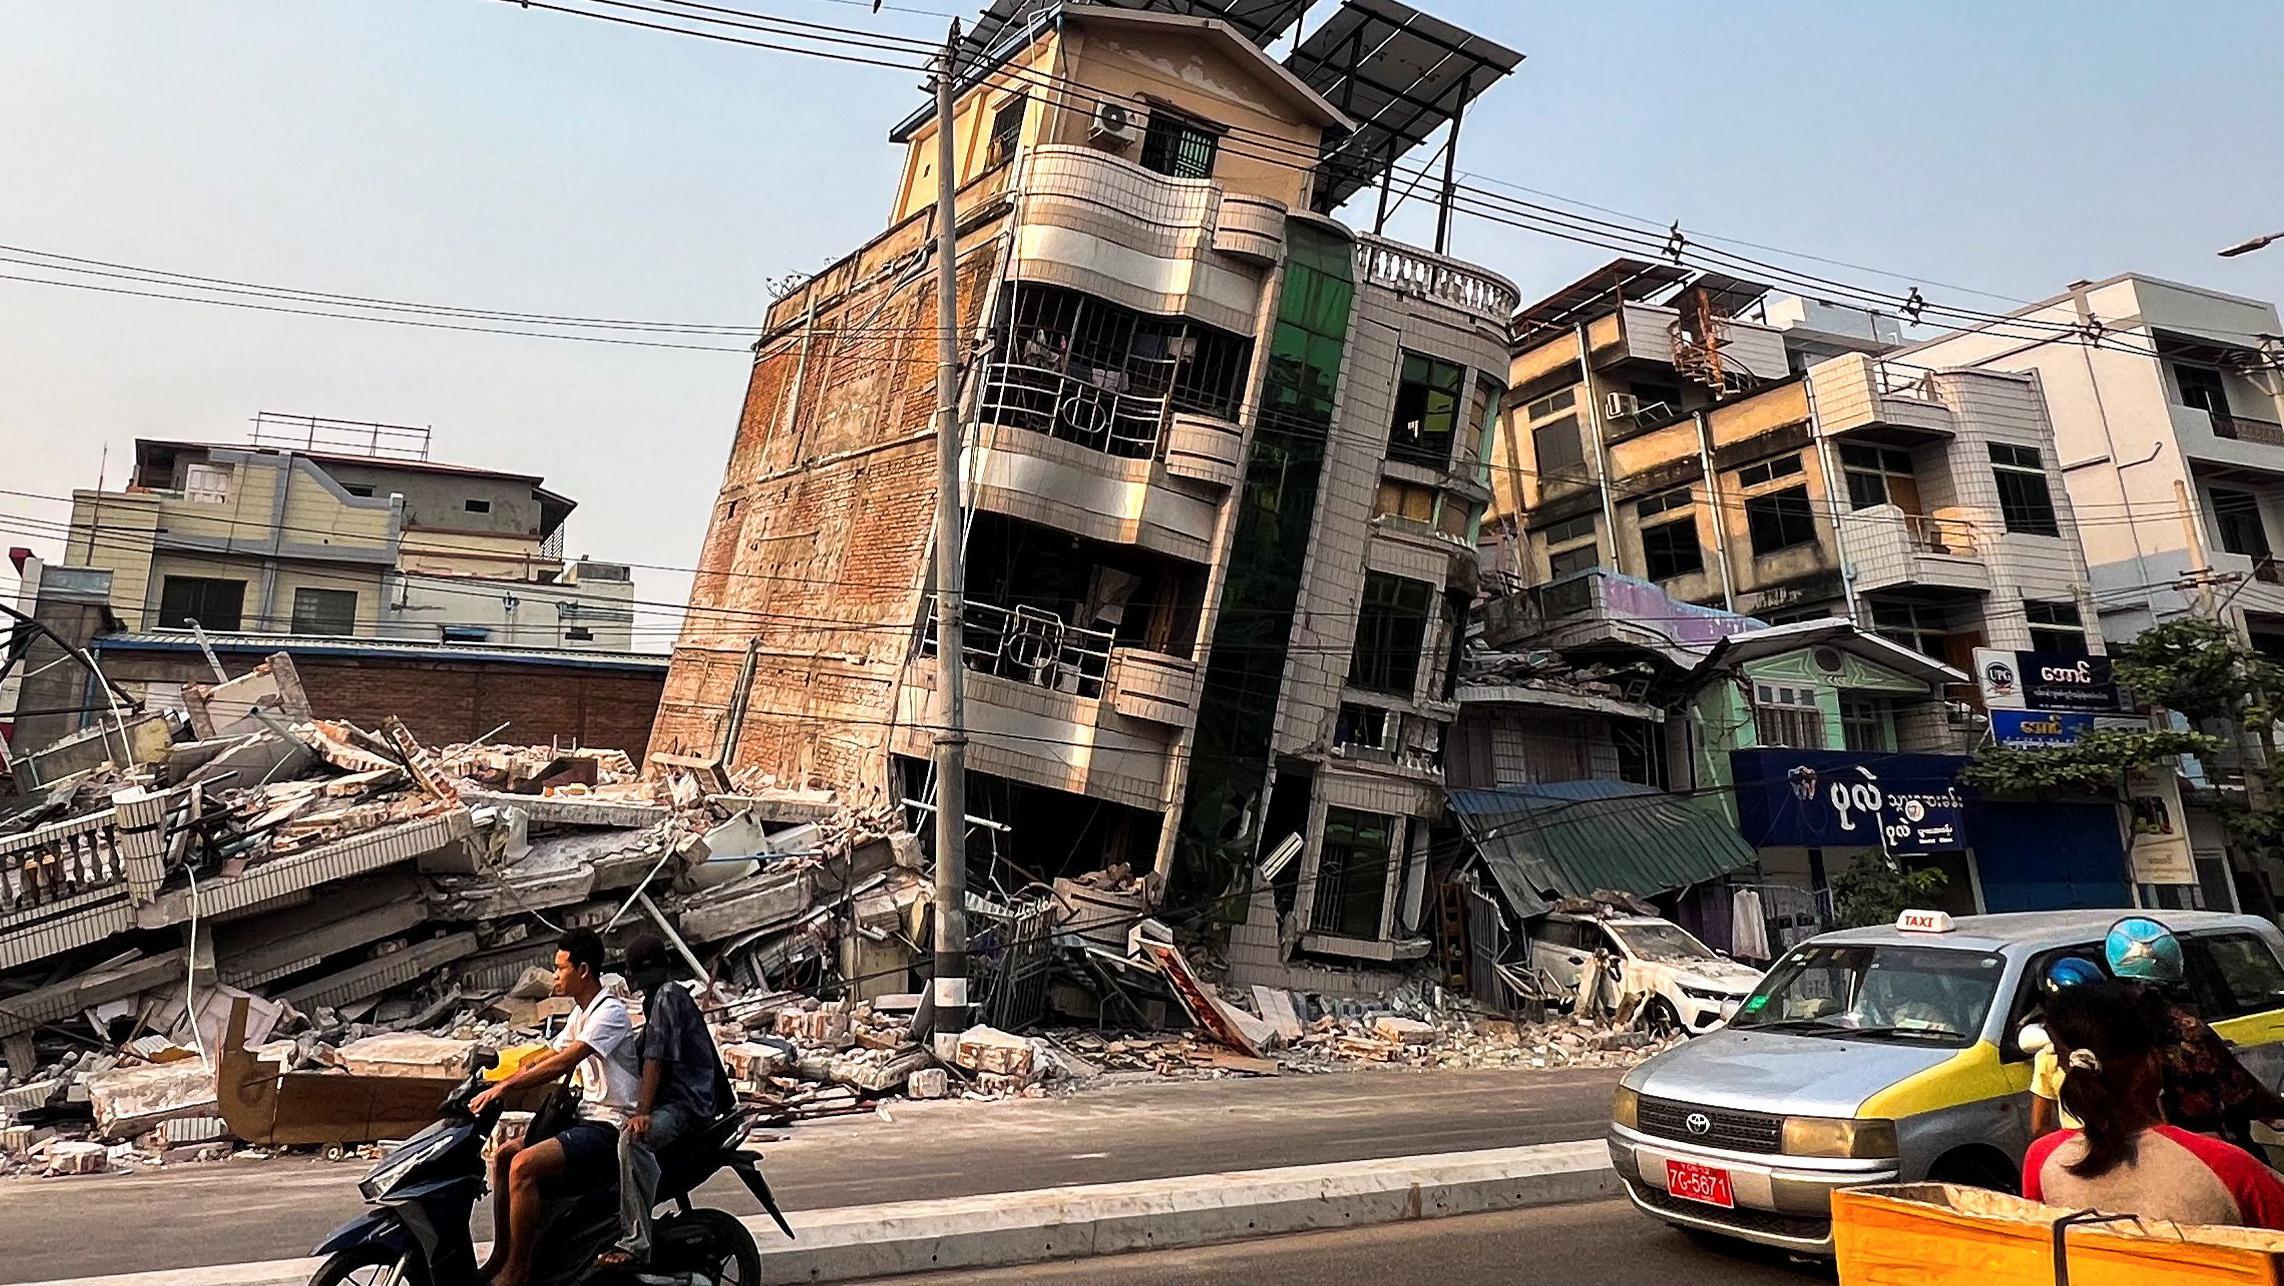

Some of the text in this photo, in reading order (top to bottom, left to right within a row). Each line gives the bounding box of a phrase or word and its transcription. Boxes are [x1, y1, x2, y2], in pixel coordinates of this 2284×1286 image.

[2041, 660, 2091, 683] အောင်
[1830, 765, 1882, 831] ပုလဲ
[1905, 915, 1933, 928] TAXI
[1669, 1168, 1727, 1198] 7G-5671
